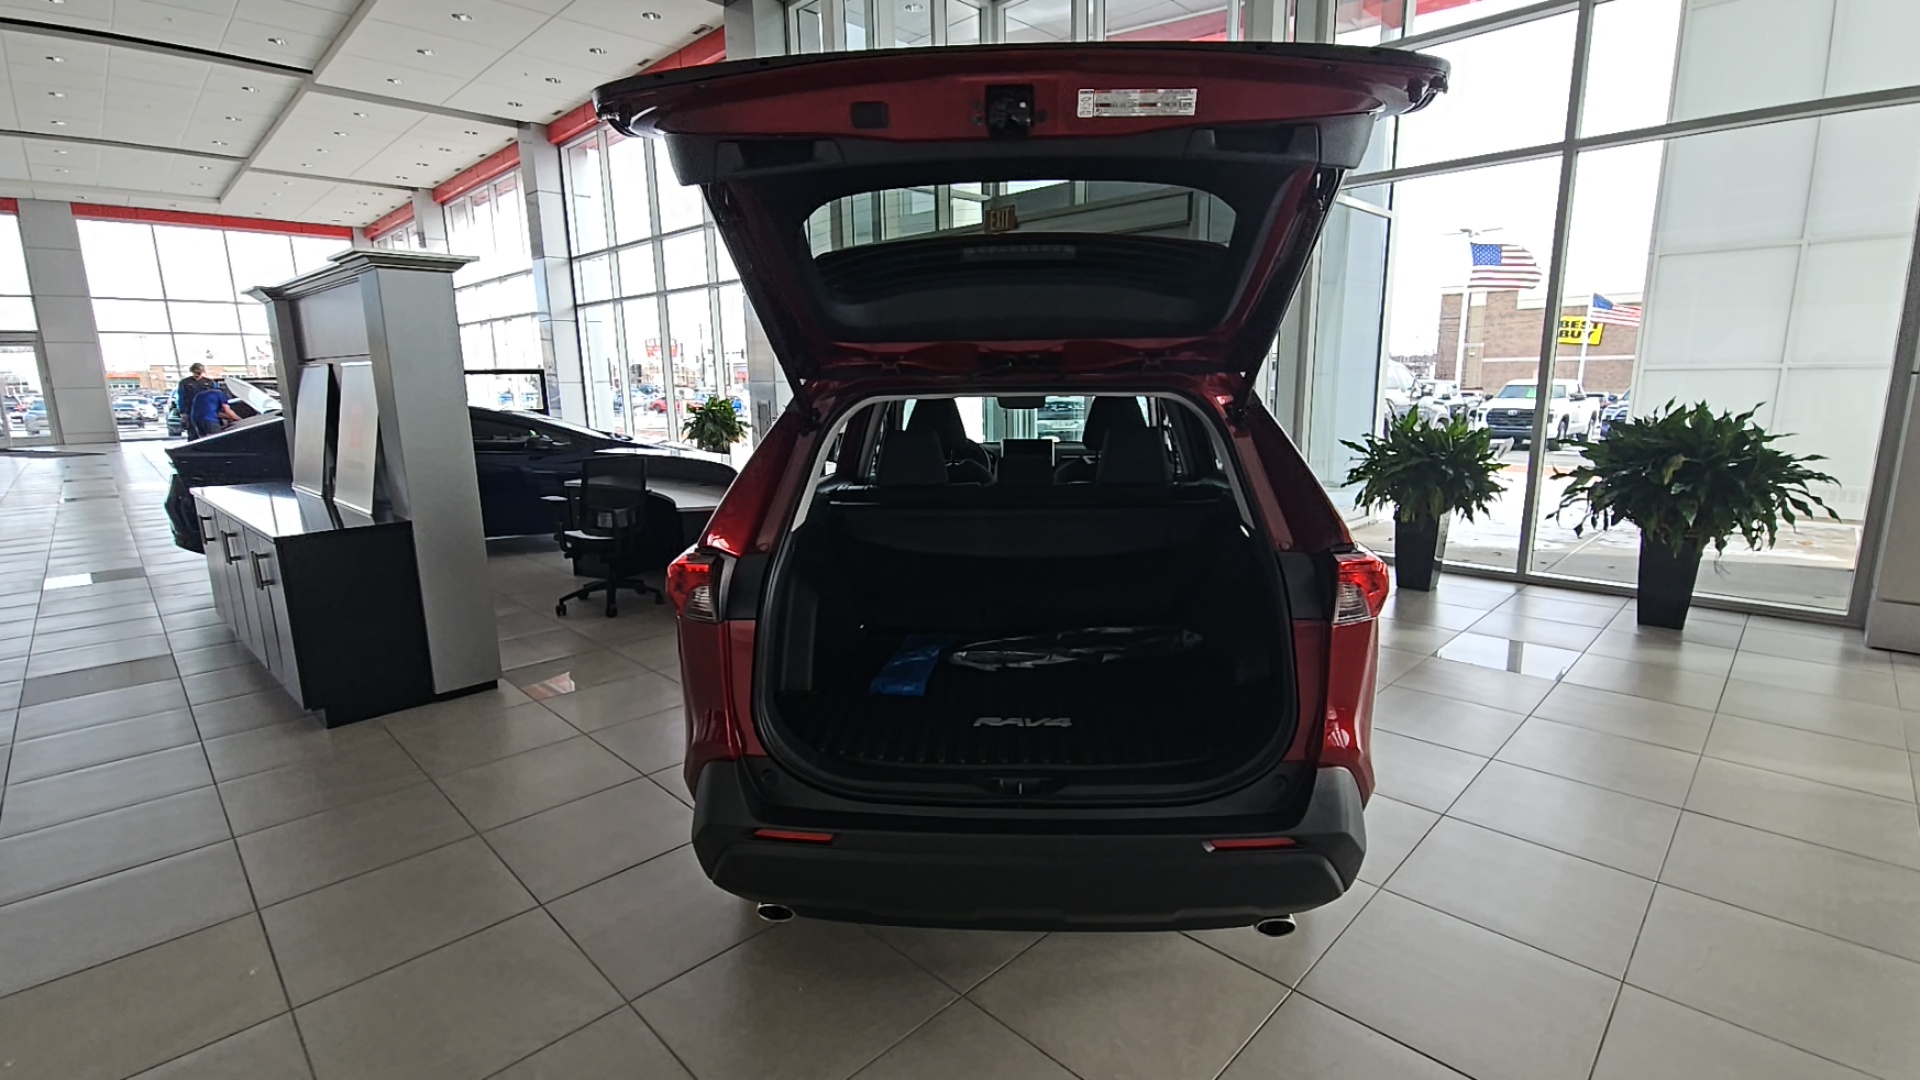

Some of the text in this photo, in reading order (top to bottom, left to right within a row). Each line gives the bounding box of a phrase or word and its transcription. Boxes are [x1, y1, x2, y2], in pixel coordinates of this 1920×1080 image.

[990, 207, 1010, 231] EXIT
[1560, 320, 1600, 330] BEST
[973, 717, 1072, 728] RAV4
